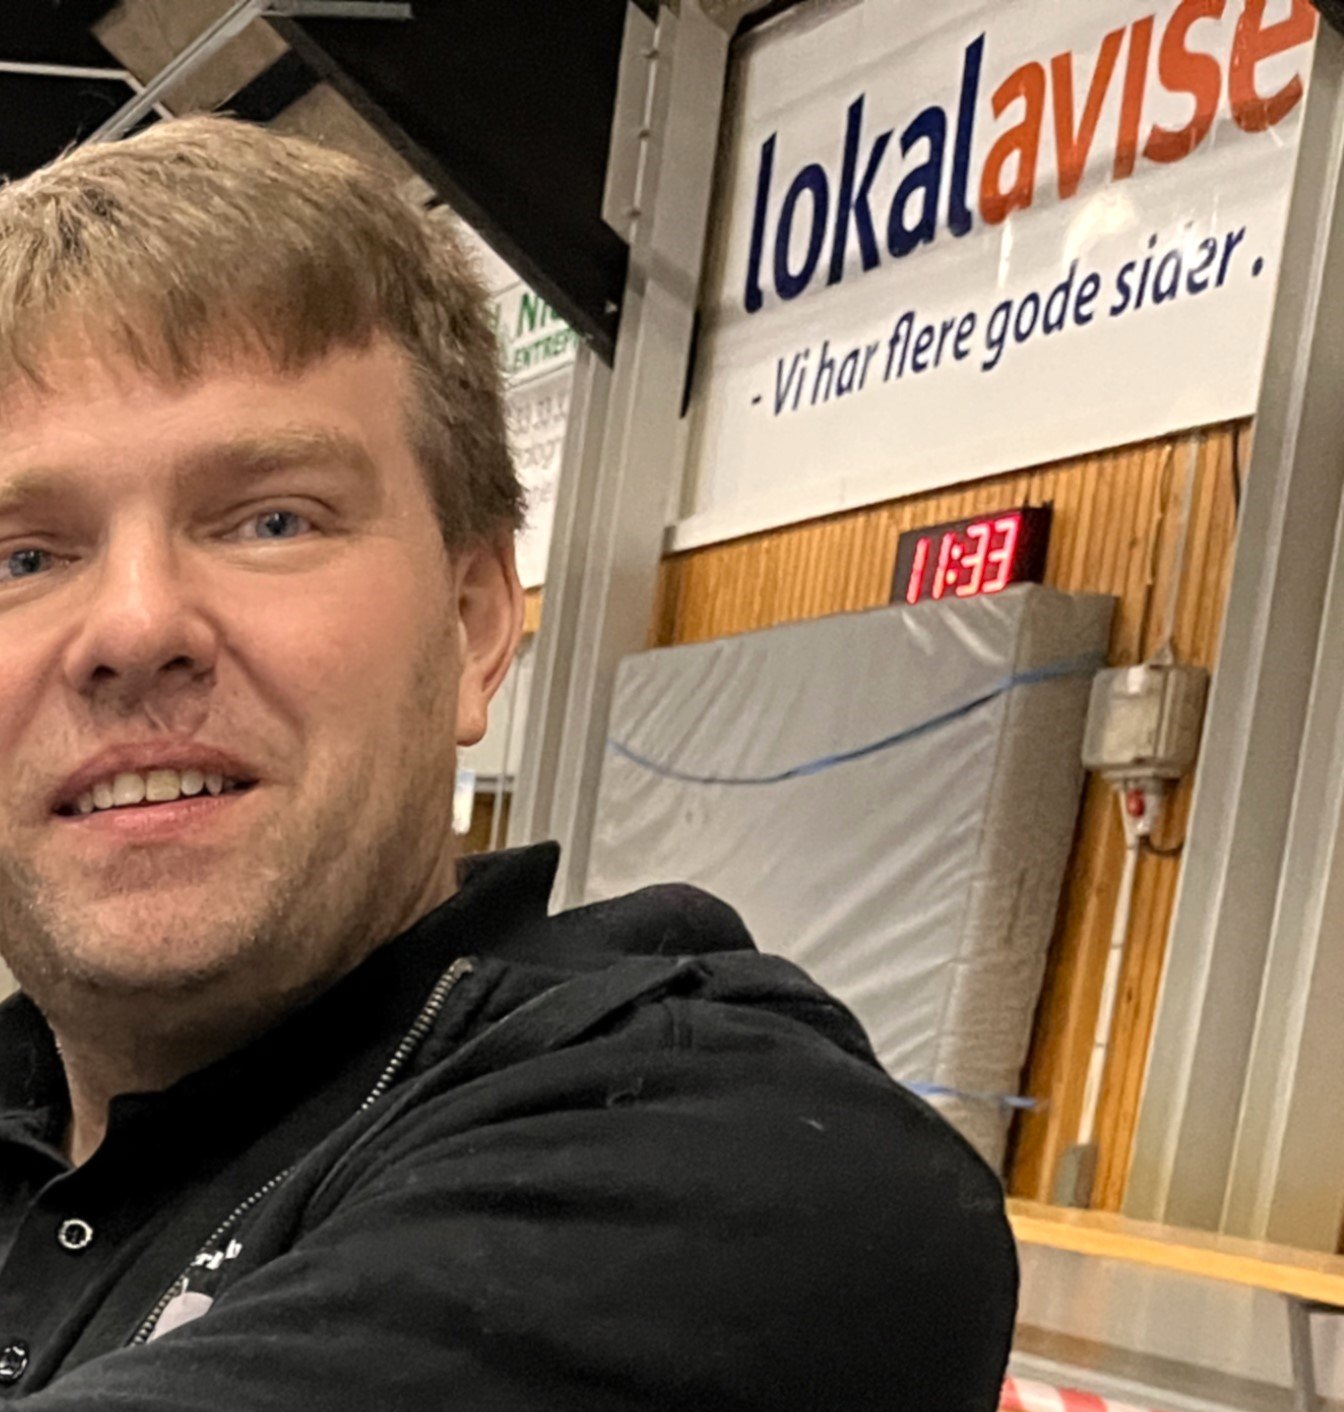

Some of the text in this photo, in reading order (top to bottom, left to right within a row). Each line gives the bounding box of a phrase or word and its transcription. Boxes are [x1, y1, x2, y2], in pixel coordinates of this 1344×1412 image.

[773, 347, 810, 416] Vi
[811, 340, 876, 403] har
[884, 310, 973, 383] flere
[980, 259, 1101, 371] gode
[906, 512, 1022, 605] 11:33
